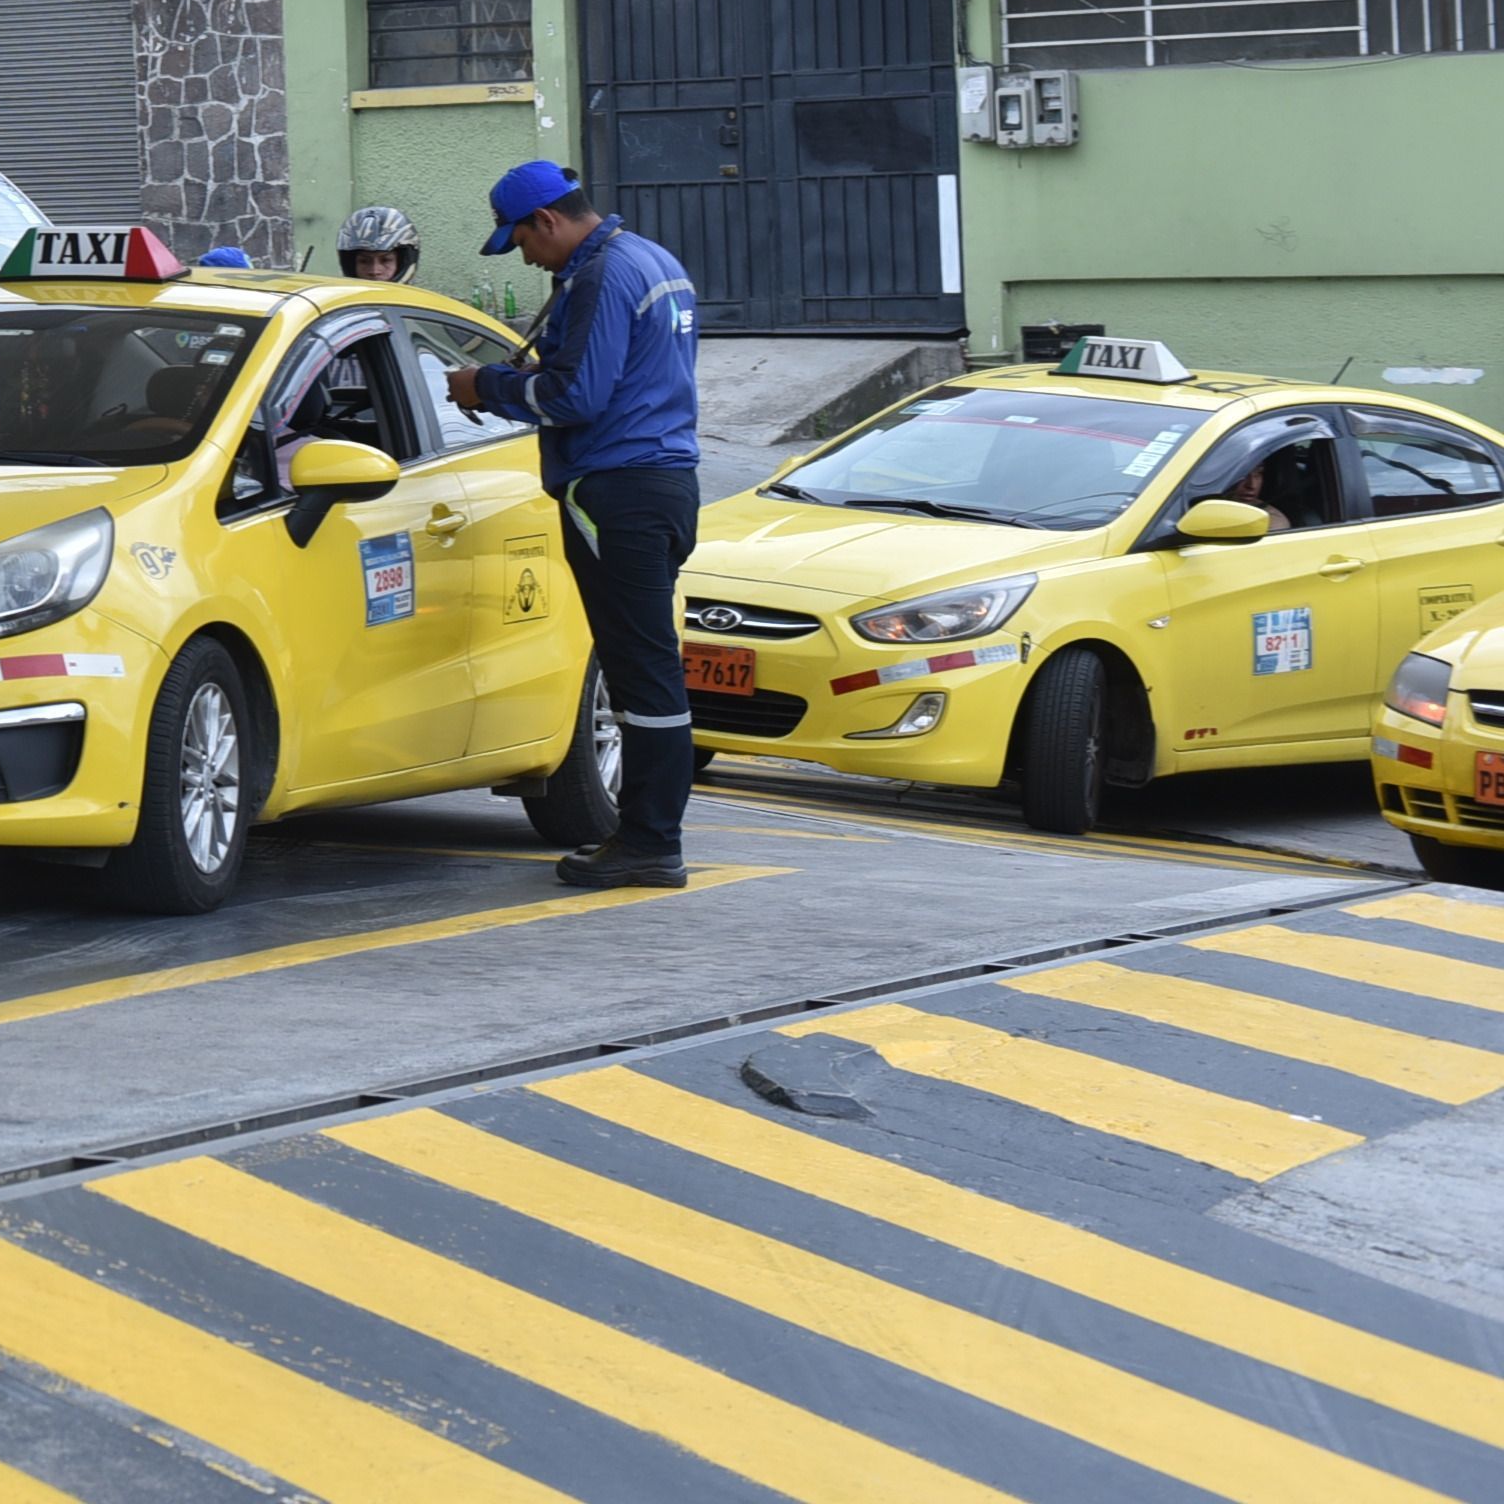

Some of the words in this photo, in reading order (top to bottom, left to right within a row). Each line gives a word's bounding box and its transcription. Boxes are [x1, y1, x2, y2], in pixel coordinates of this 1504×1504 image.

[35, 232, 130, 265] TAXI
[1084, 343, 1147, 371] TAXI
[374, 566, 404, 593] 2898
